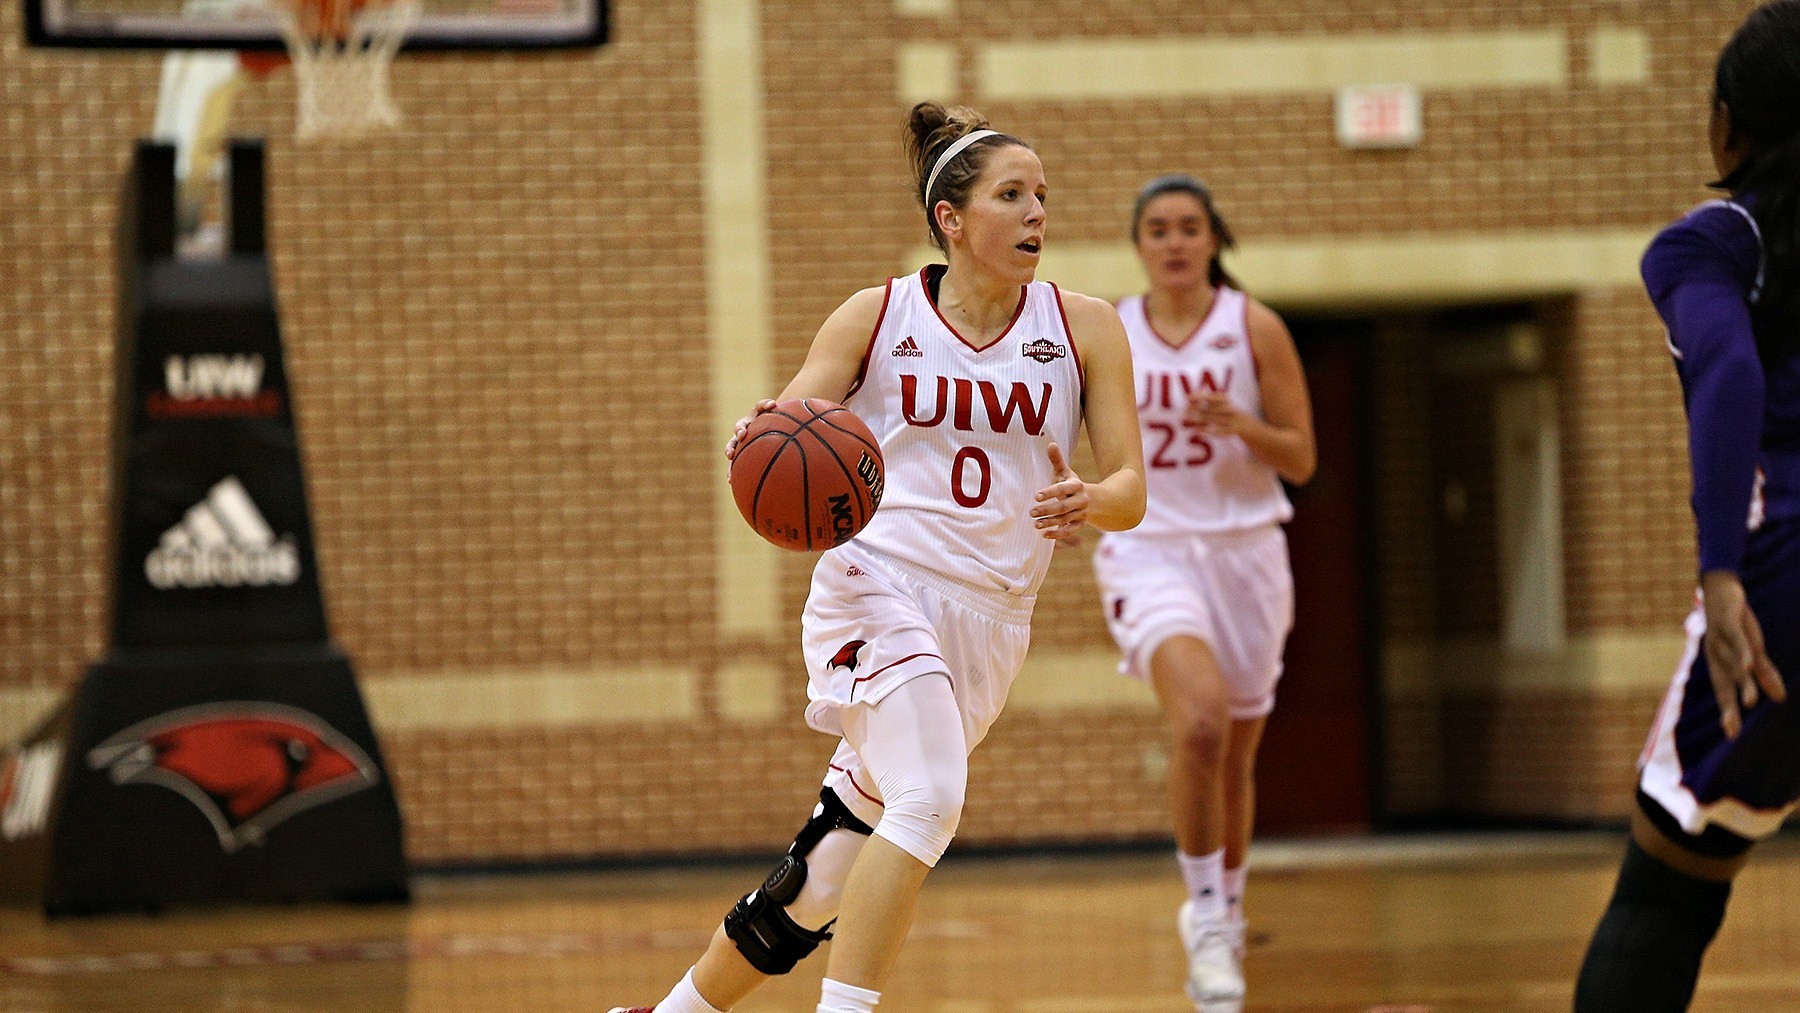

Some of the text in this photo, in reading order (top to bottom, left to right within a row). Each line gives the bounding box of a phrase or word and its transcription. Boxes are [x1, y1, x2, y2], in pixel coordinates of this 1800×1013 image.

[891, 348, 923, 357] adidas
[1023, 344, 1065, 356] SOUTHLAND
[165, 353, 264, 400] UIW
[899, 374, 1053, 436] UIW
[1147, 421, 1213, 468] 23
[951, 446, 991, 508] 0
[828, 493, 854, 545] NCA
